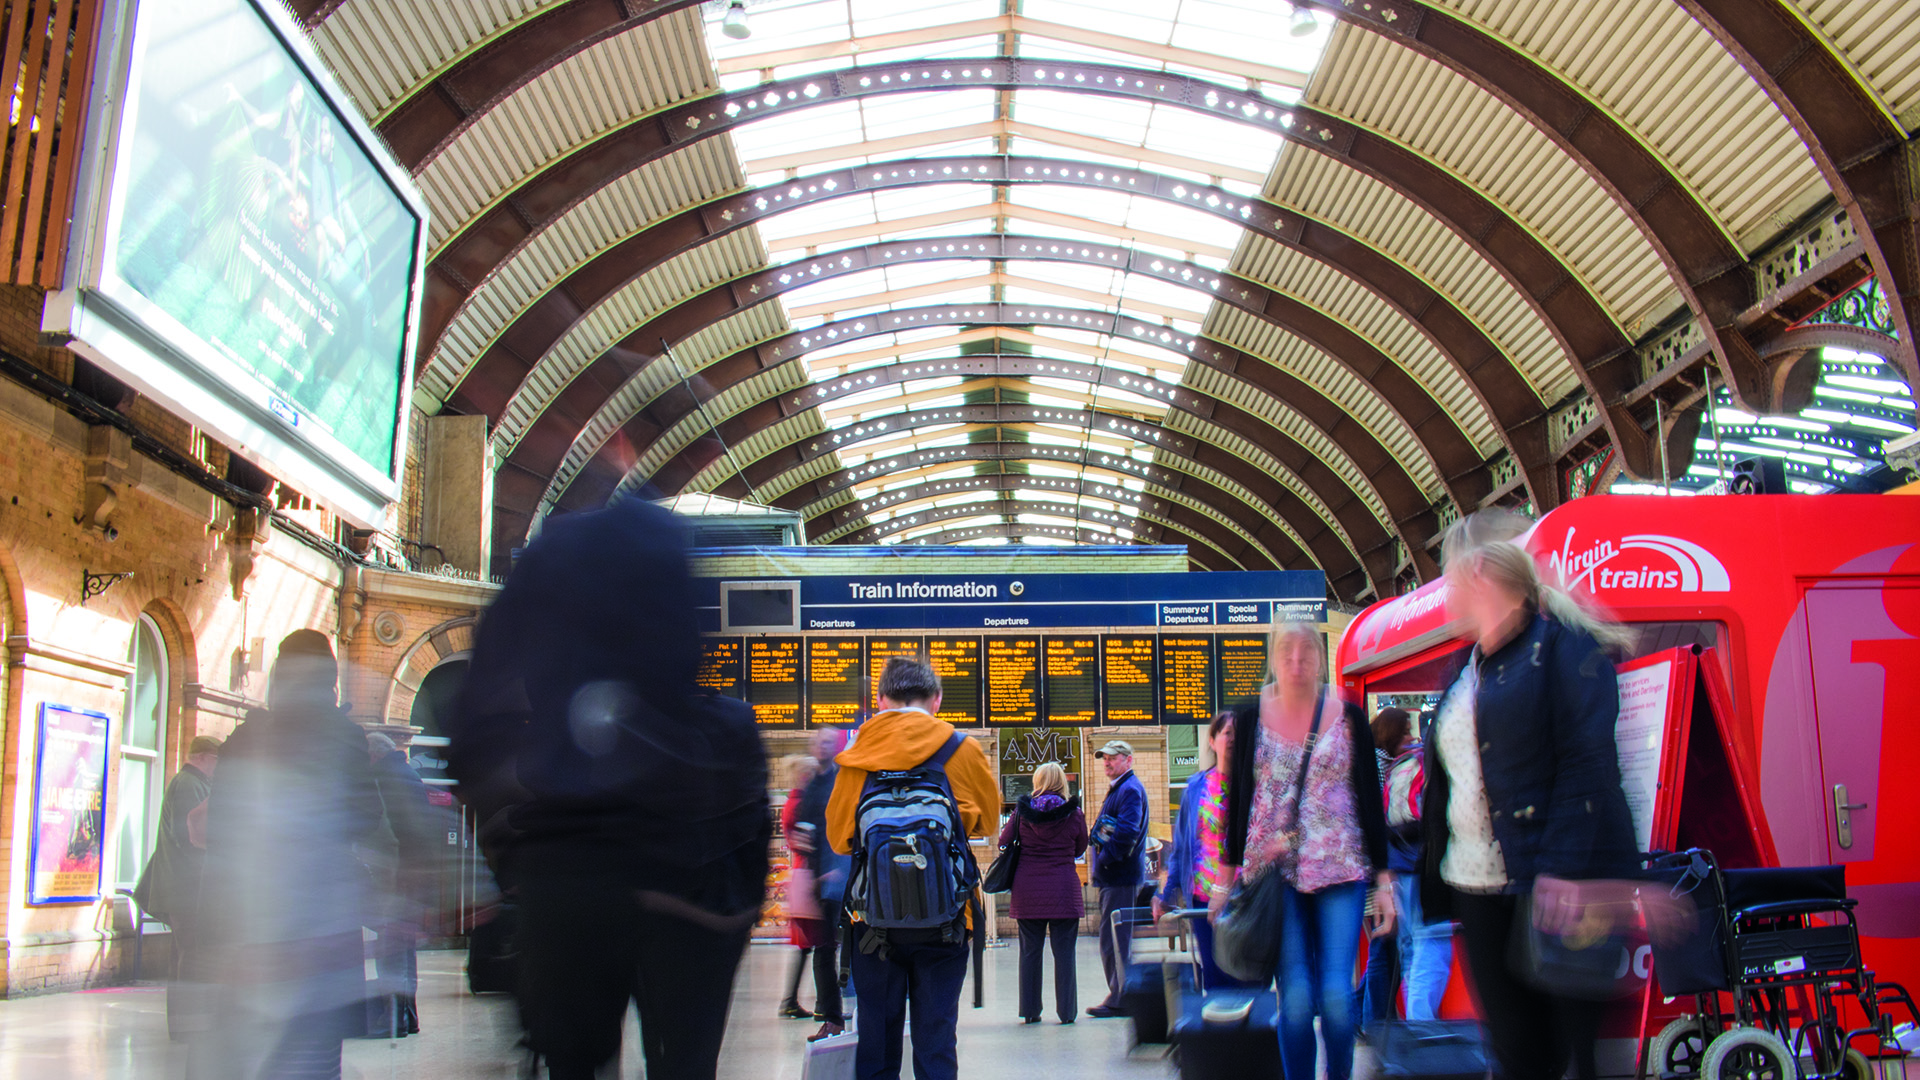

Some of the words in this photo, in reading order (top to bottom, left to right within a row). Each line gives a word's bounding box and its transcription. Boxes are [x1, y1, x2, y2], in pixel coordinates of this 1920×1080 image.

[240, 208, 261, 240] Some
[262, 229, 283, 261] hotels
[282, 255, 297, 274] you
[296, 268, 312, 290] want
[311, 282, 319, 297] to
[319, 290, 331, 310] stay
[1549, 526, 1619, 594] Virgin
[1600, 566, 1678, 589] trains
[849, 582, 893, 598] Train
[896, 582, 997, 598] Information
[1163, 606, 1200, 615] Summary
[1201, 605, 1209, 613] of
[1228, 605, 1257, 614] Special
[1276, 603, 1313, 613] Summary
[1314, 603, 1323, 611] of
[1165, 615, 1208, 624] Departures
[1286, 612, 1315, 620] Arrivals
[810, 619, 855, 629] Departures
[984, 617, 1029, 626] Departures
[1641, 683, 1664, 695] Darlington
[1003, 732, 1079, 763] AMT
